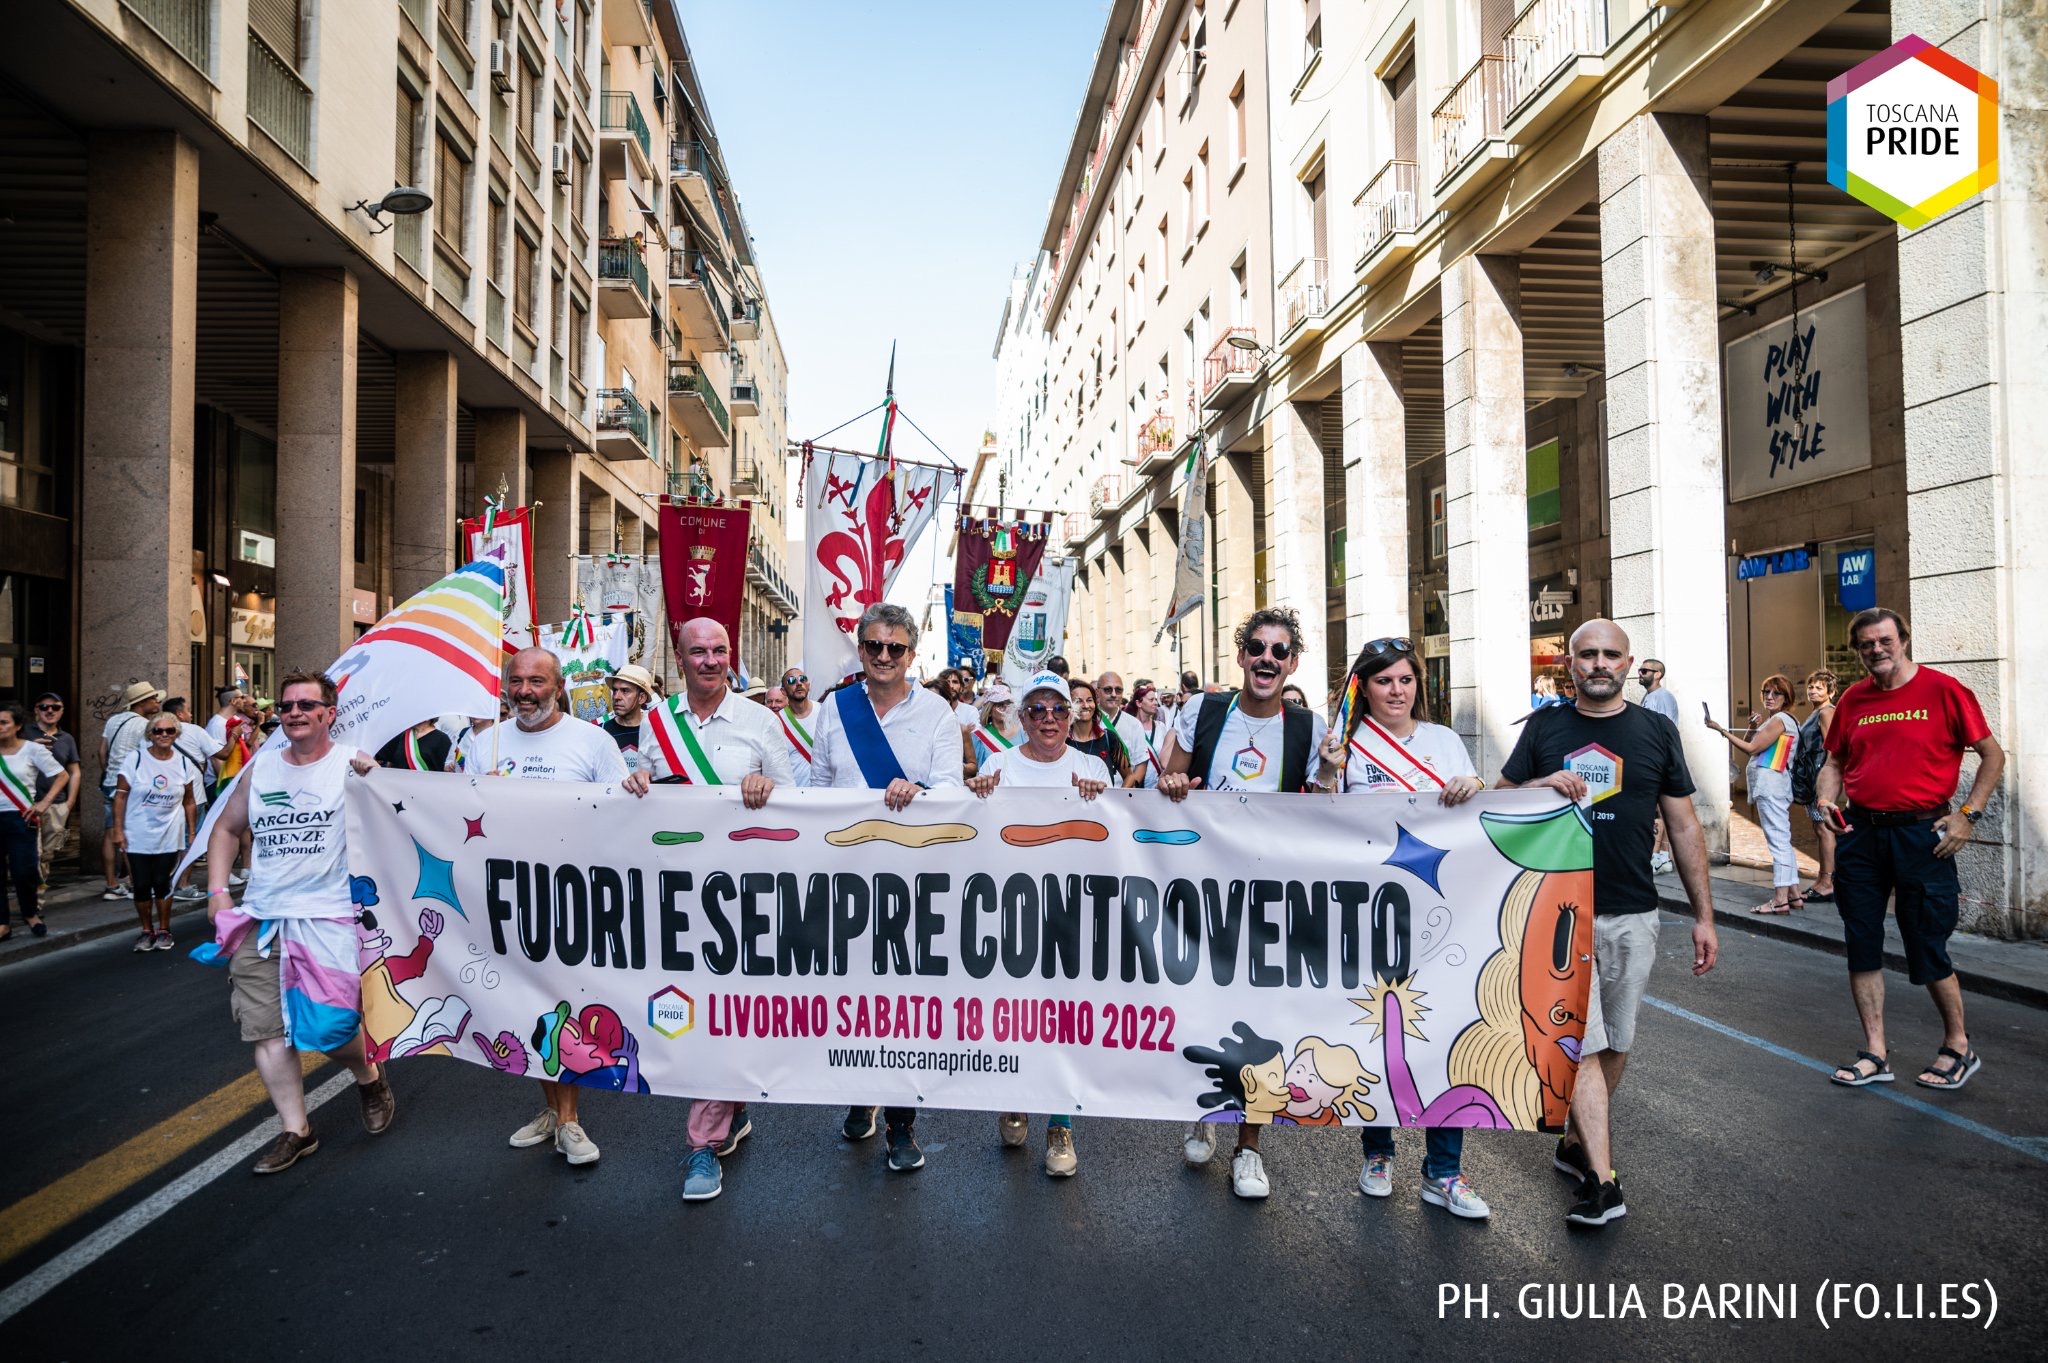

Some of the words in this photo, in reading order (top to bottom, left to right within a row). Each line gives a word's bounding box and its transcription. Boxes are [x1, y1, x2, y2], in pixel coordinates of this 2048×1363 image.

[1764, 324, 1816, 383] PLAY
[1767, 370, 1821, 427] WITH
[1769, 422, 1826, 479] STYLE
[680, 516, 727, 528] COMUNE
[1737, 557, 1767, 580] AW
[1772, 550, 1810, 574] LAB
[1842, 554, 1867, 573] AW
[1842, 575, 1859, 586] LAB
[1033, 674, 1060, 685] agedo
[1858, 709, 1928, 726] #iosono141
[522, 765, 556, 774] genitori
[1240, 760, 1258, 770] PRIDE
[1577, 763, 1609, 772] TOSCANA
[1576, 771, 1610, 784] PRIDE
[253, 810, 335, 828] ARCIGAY
[1597, 812, 1615, 820] 2019
[485, 858, 646, 970] FUORI
[659, 870, 695, 971] E
[701, 871, 951, 976] SEMPRE
[960, 872, 1412, 990] CONTROVENTO
[658, 1003, 684, 1011] TOSCANA
[658, 1010, 684, 1020] PRIDE
[708, 993, 829, 1038] LIVORNO
[836, 994, 942, 1040] SABATO
[953, 996, 984, 1042] 18
[992, 998, 1094, 1046] GIUGNO
[1101, 1003, 1176, 1052] 2022
[828, 1044, 1019, 1075] www.toscanapride.eu
